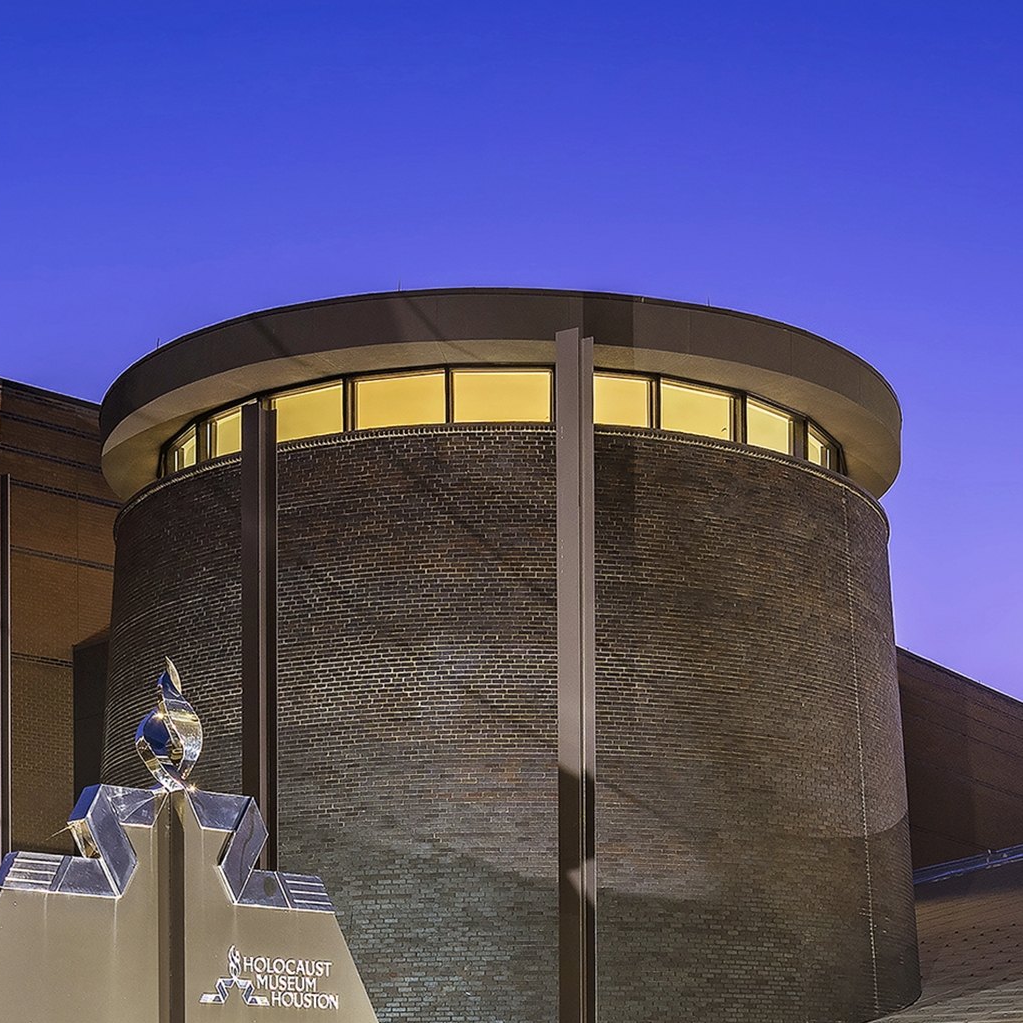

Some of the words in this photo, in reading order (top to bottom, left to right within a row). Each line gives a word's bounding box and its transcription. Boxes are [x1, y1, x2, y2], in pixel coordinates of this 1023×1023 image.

[243, 957, 332, 977] HOLOCAUST
[256, 974, 317, 992] MUSEUM
[271, 991, 339, 1010] HOUSTON
